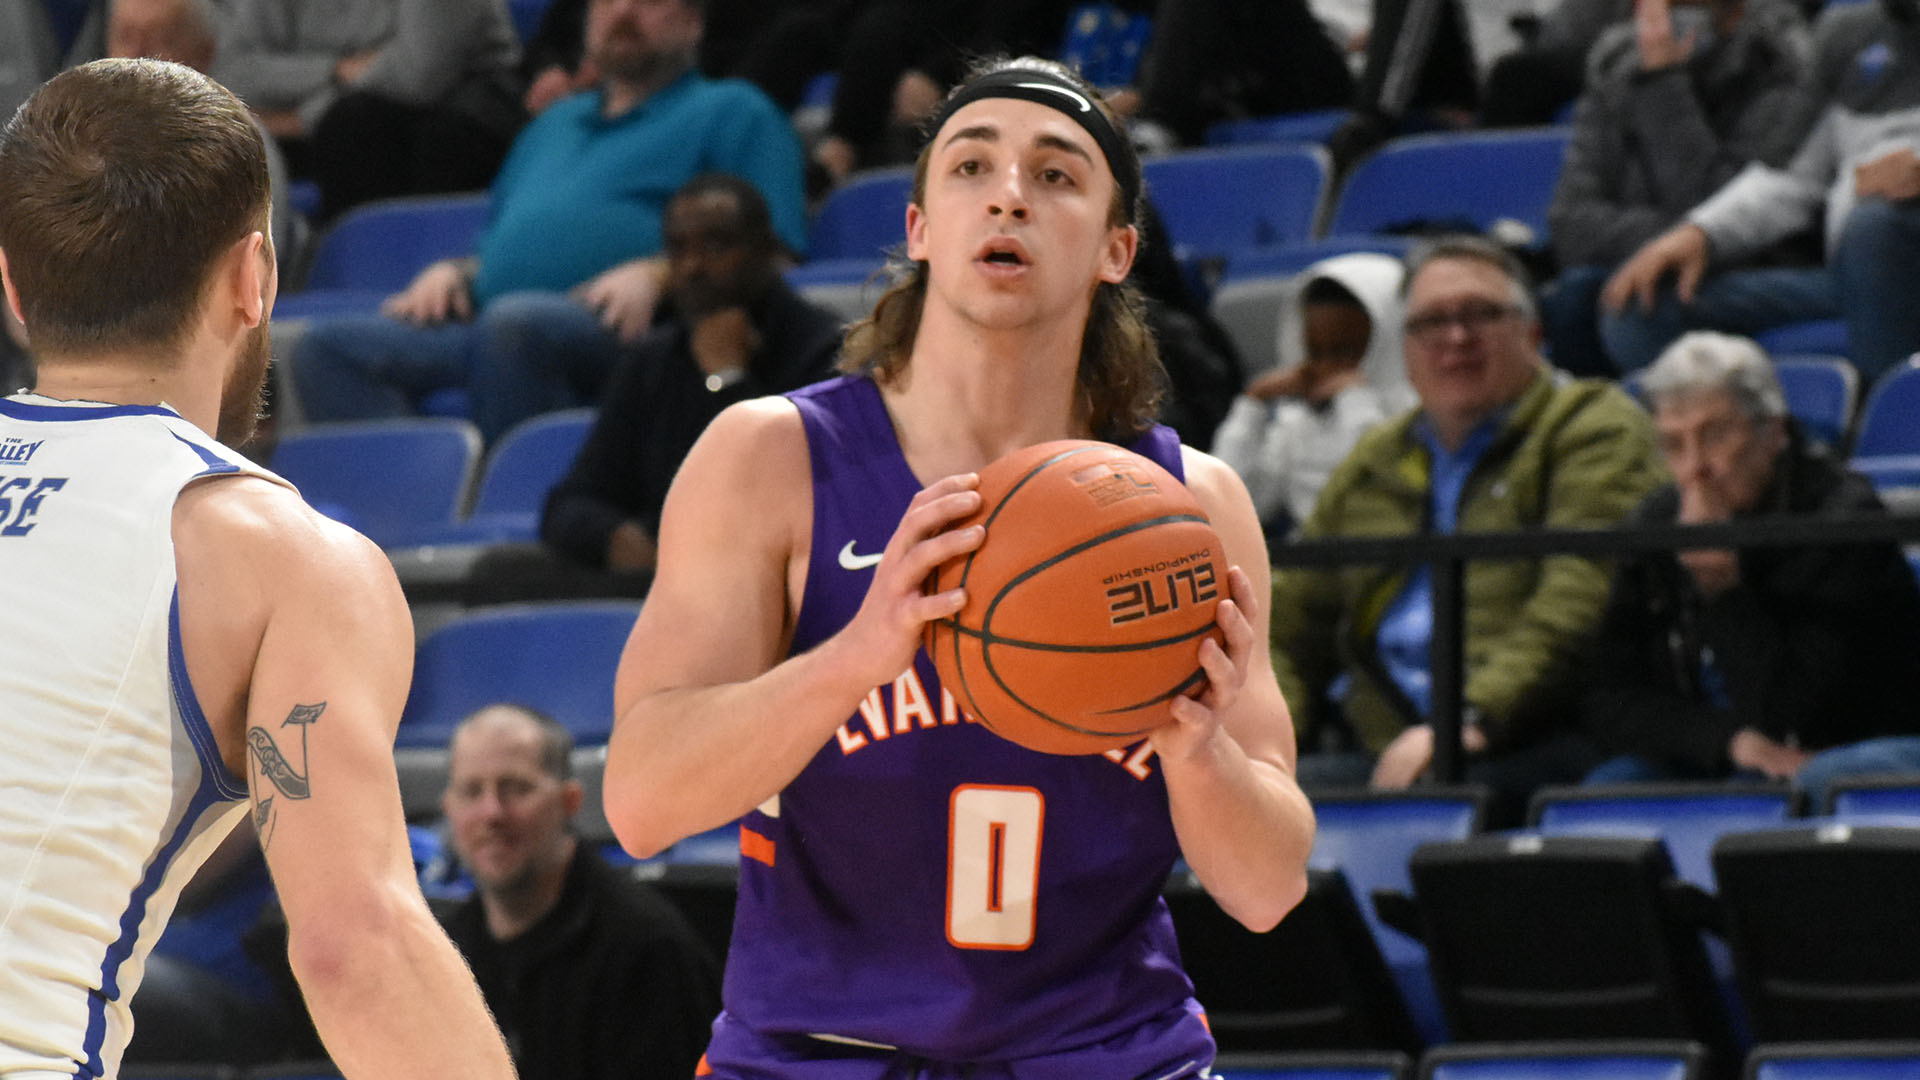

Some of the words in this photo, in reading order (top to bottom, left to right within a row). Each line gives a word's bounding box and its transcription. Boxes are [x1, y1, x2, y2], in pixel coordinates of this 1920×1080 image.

[0, 439, 45, 461] LLEY
[1102, 548, 1210, 585] CHAMPIONSHIP
[1106, 562, 1218, 624] ELITE
[945, 783, 1045, 951] 0
